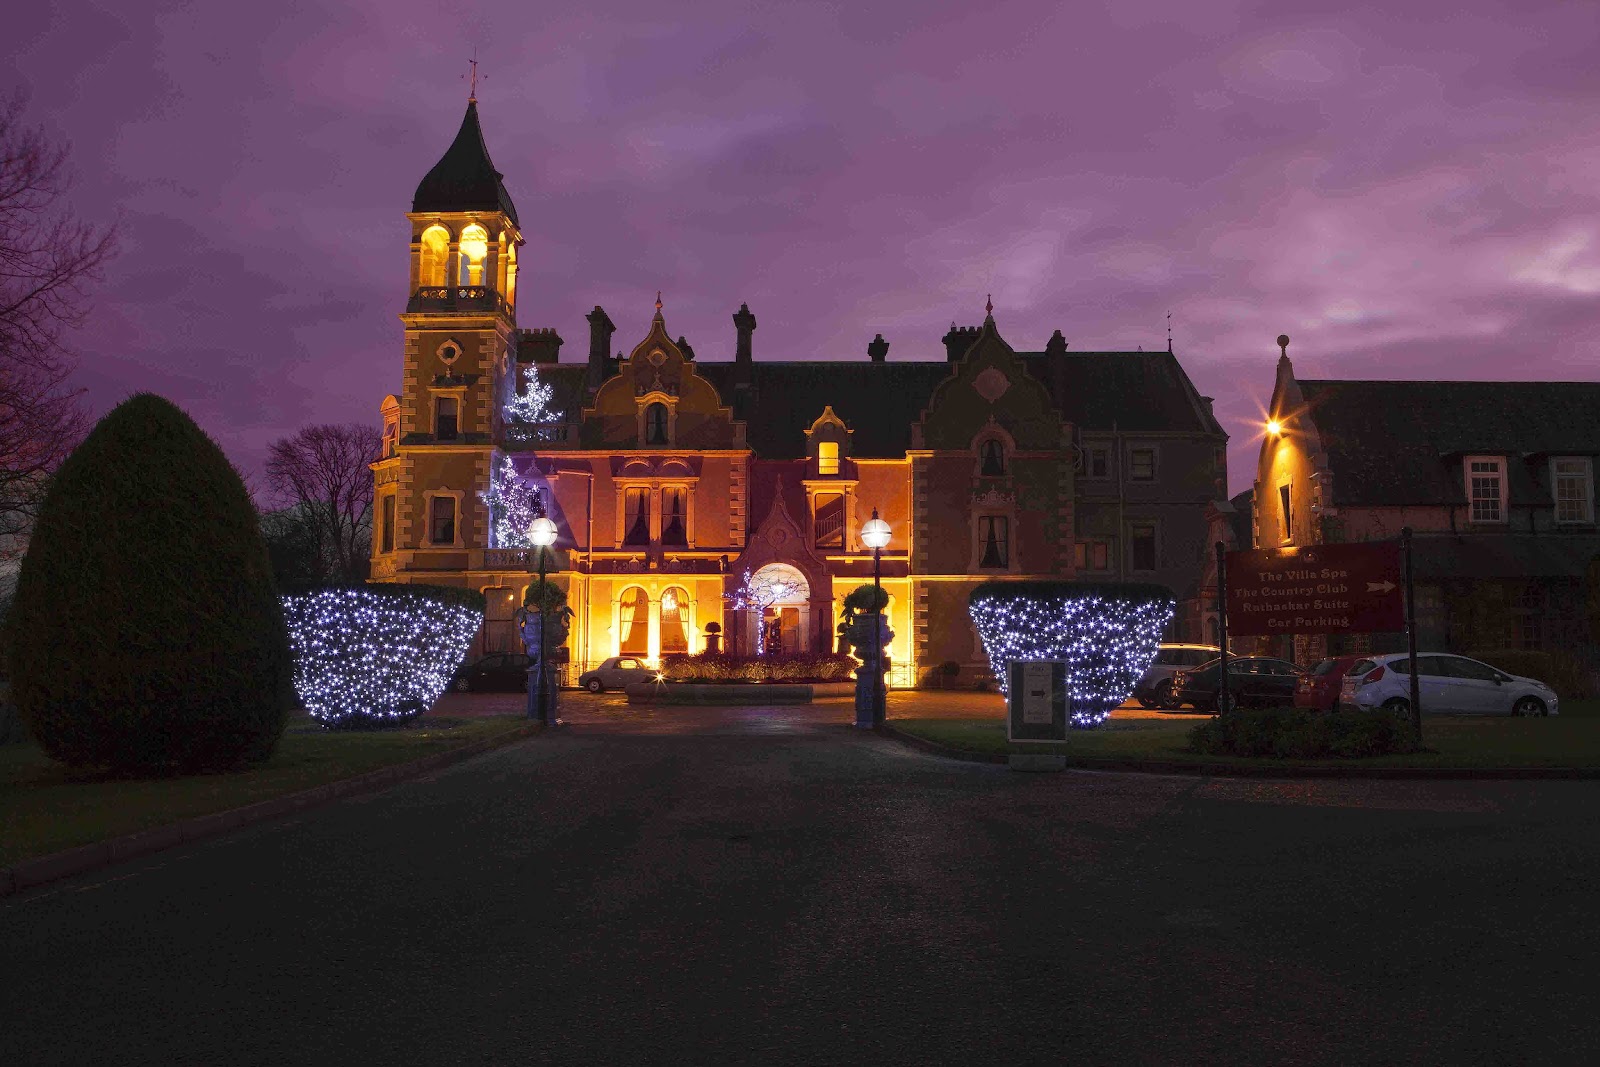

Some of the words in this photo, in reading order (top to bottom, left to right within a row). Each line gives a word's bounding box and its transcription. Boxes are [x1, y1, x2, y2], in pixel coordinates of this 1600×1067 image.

[1258, 571, 1282, 582] The
[1285, 569, 1317, 580] Villa
[1320, 568, 1347, 579] Spa
[1234, 588, 1258, 598] The
[1261, 585, 1314, 597] Country
[1316, 583, 1348, 594] Club
[1313, 599, 1349, 610] Suite
[1267, 618, 1291, 628] Car
[1295, 616, 1350, 628] Parking
